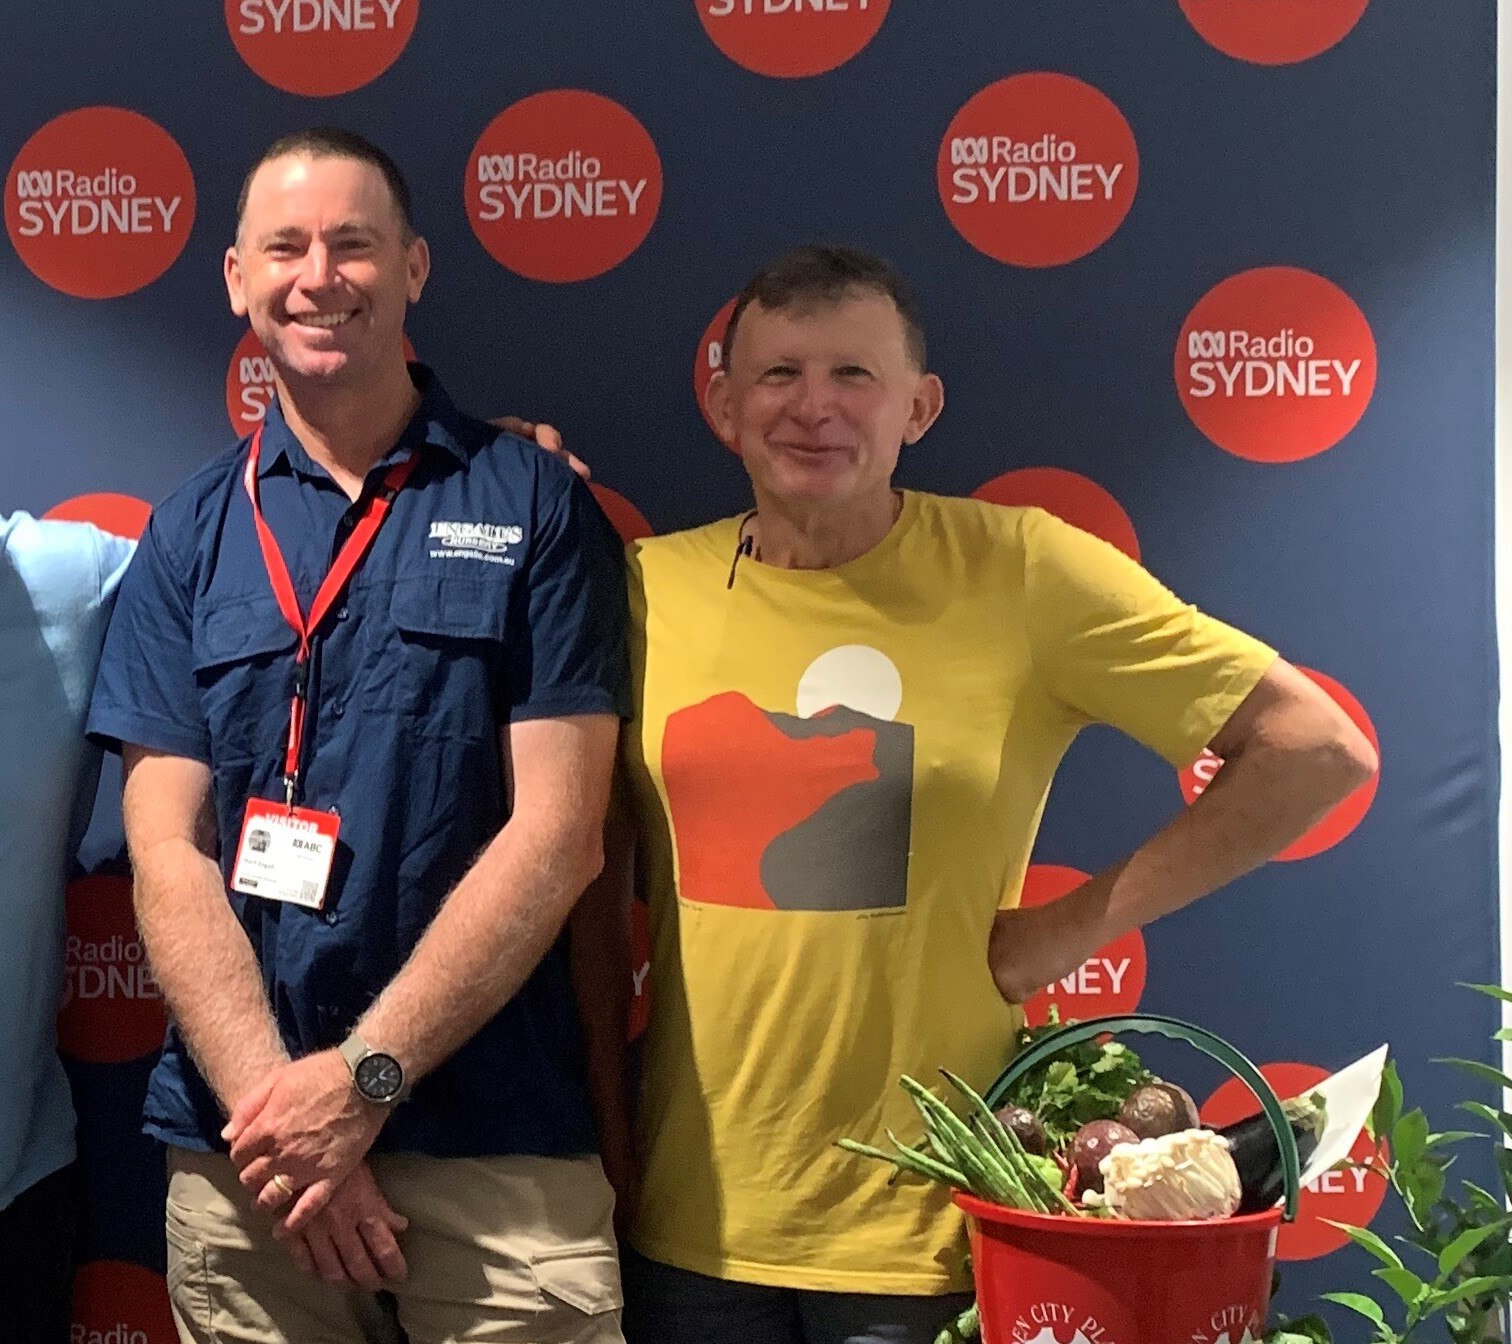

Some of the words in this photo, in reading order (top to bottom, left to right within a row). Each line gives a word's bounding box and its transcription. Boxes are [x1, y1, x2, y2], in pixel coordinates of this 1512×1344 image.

[991, 134, 1077, 163] Radio
[518, 152, 602, 180] Radio
[56, 168, 138, 197] Radio
[951, 164, 1123, 203] SYDNEY
[478, 178, 647, 221] SYDNEY
[17, 196, 182, 237] SYDNEY
[1228, 330, 1314, 358] Radio
[1188, 358, 1361, 397] SYDNEY
[1030, 1301, 1075, 1324] CITY
[1210, 1304, 1248, 1332] CITY
